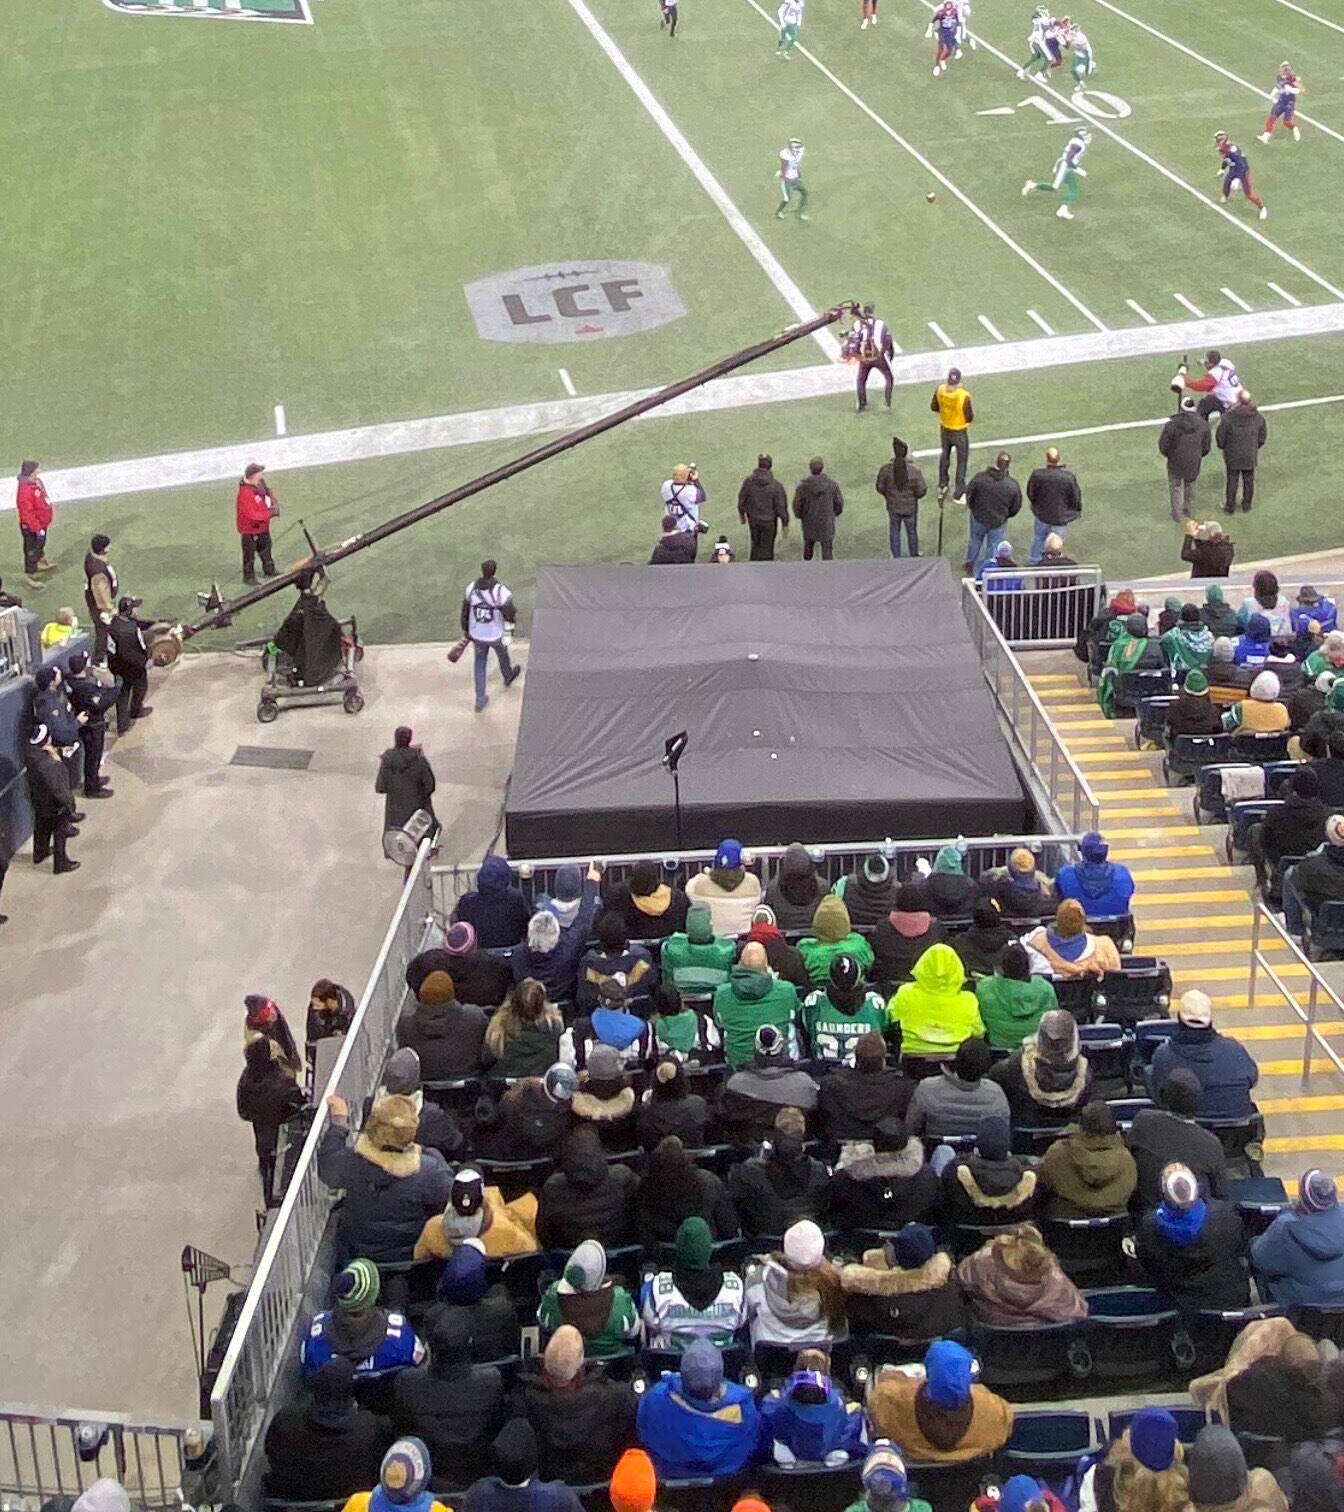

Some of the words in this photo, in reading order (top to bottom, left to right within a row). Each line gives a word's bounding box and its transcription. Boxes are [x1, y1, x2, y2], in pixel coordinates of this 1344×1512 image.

[1016, 90, 1133, 126] 10
[500, 278, 646, 327] LCF
[815, 1020, 873, 1035] SAUNDERS
